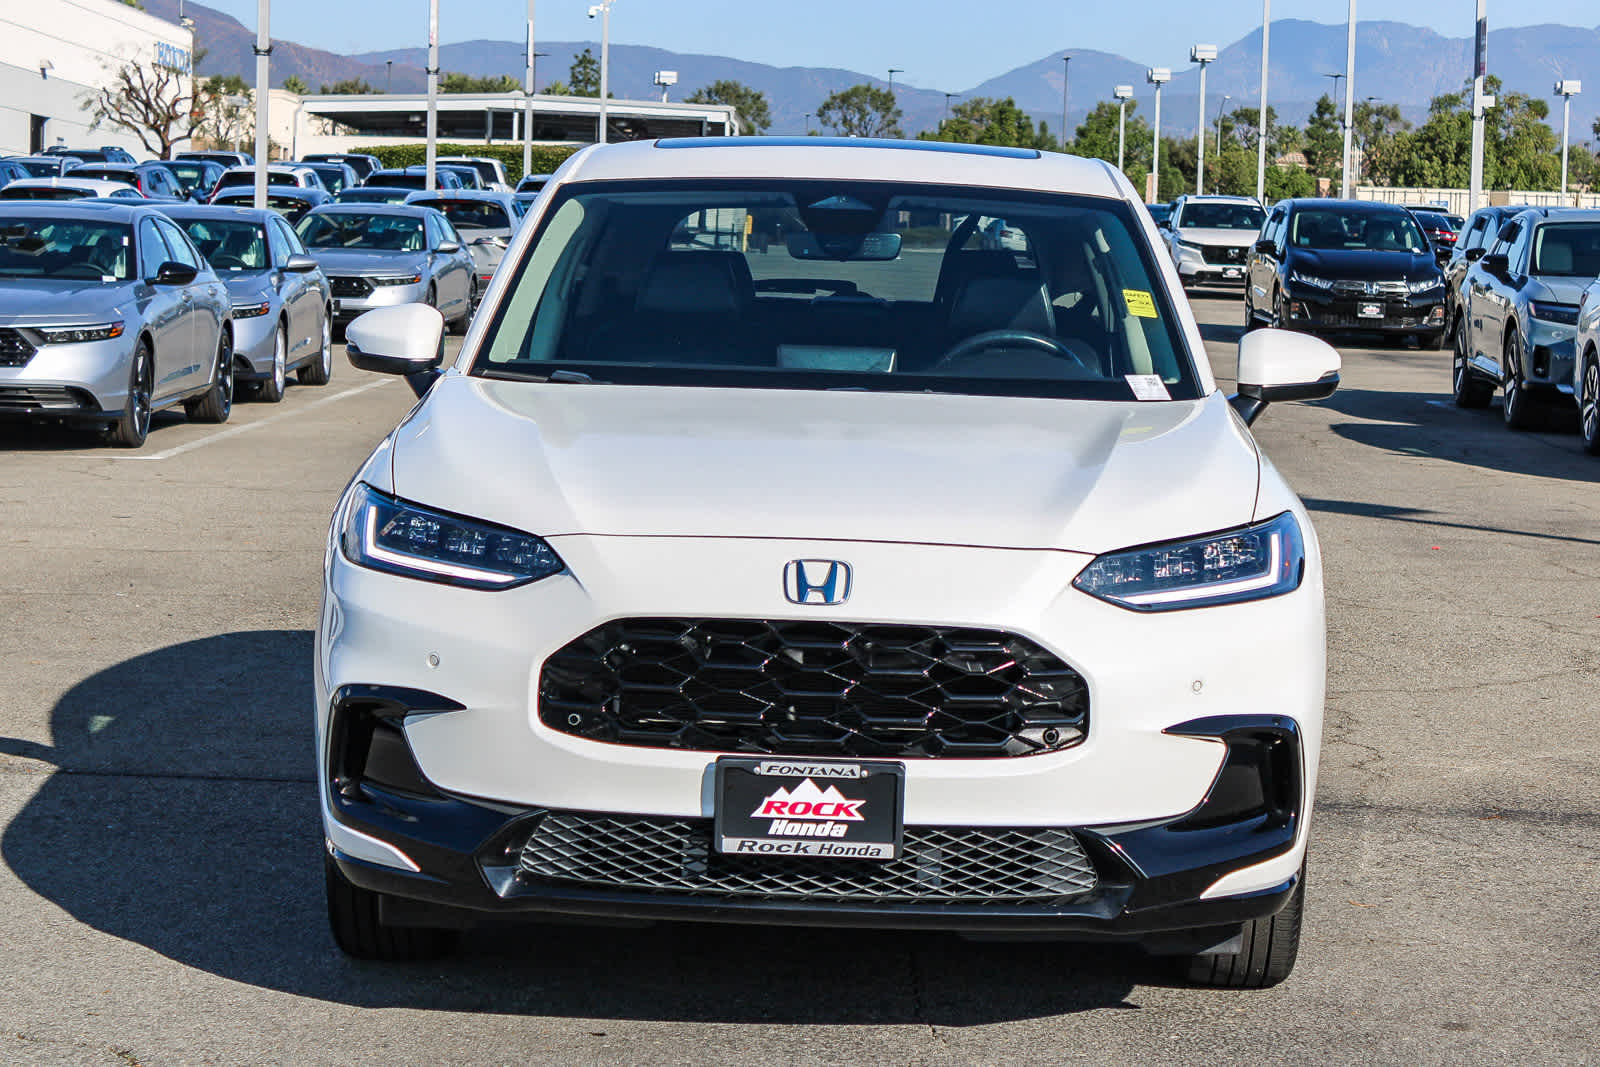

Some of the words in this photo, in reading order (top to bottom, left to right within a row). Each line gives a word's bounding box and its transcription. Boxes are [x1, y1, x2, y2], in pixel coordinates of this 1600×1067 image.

[157, 41, 192, 72] HONDA
[766, 765, 857, 777] FONTANA
[762, 800, 858, 817] ROCK
[768, 819, 849, 838] Honda
[737, 840, 810, 854] Rock
[818, 843, 882, 857] Honda
